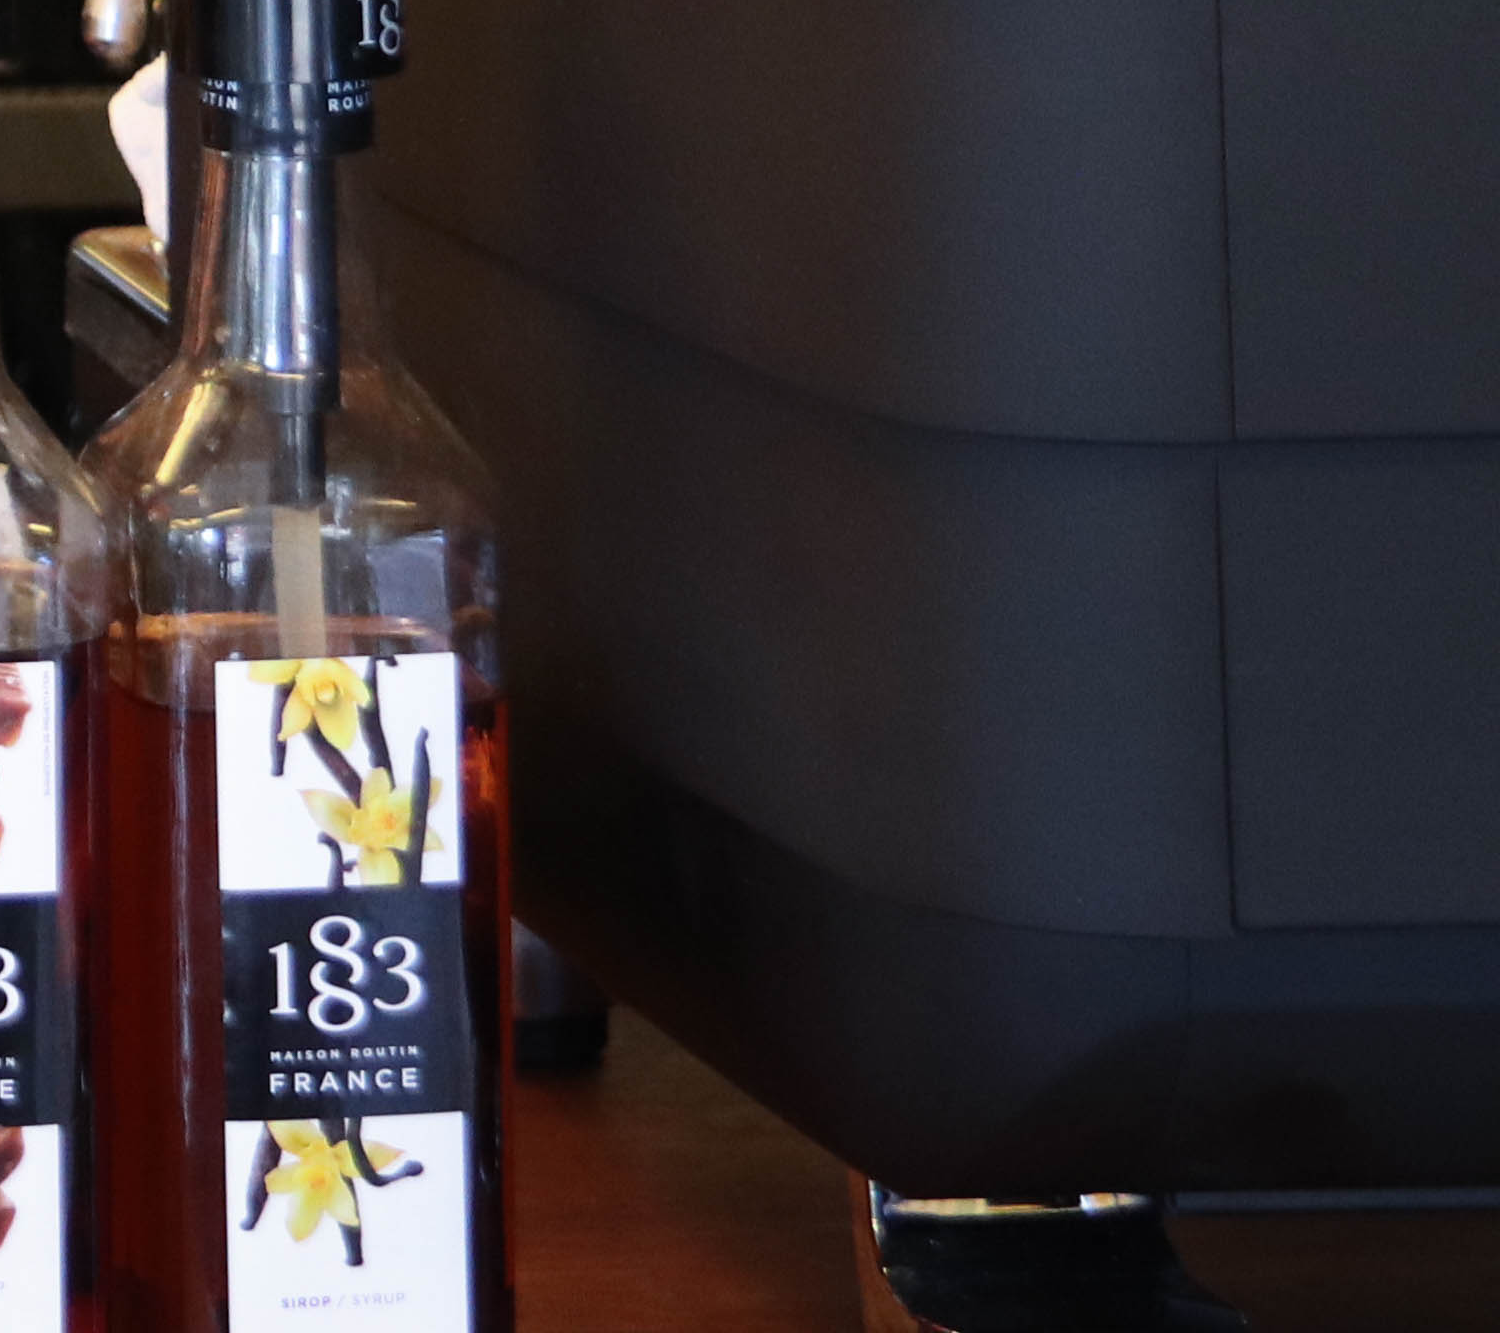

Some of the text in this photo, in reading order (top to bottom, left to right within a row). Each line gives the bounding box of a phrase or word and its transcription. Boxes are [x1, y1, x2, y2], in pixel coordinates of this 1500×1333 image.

[269, 1044, 419, 1062] MAISON ROUTIN
[268, 1067, 419, 1094] FRANCE
[281, 1295, 332, 1309] SIROP
[352, 1292, 406, 1306] SYRUP
